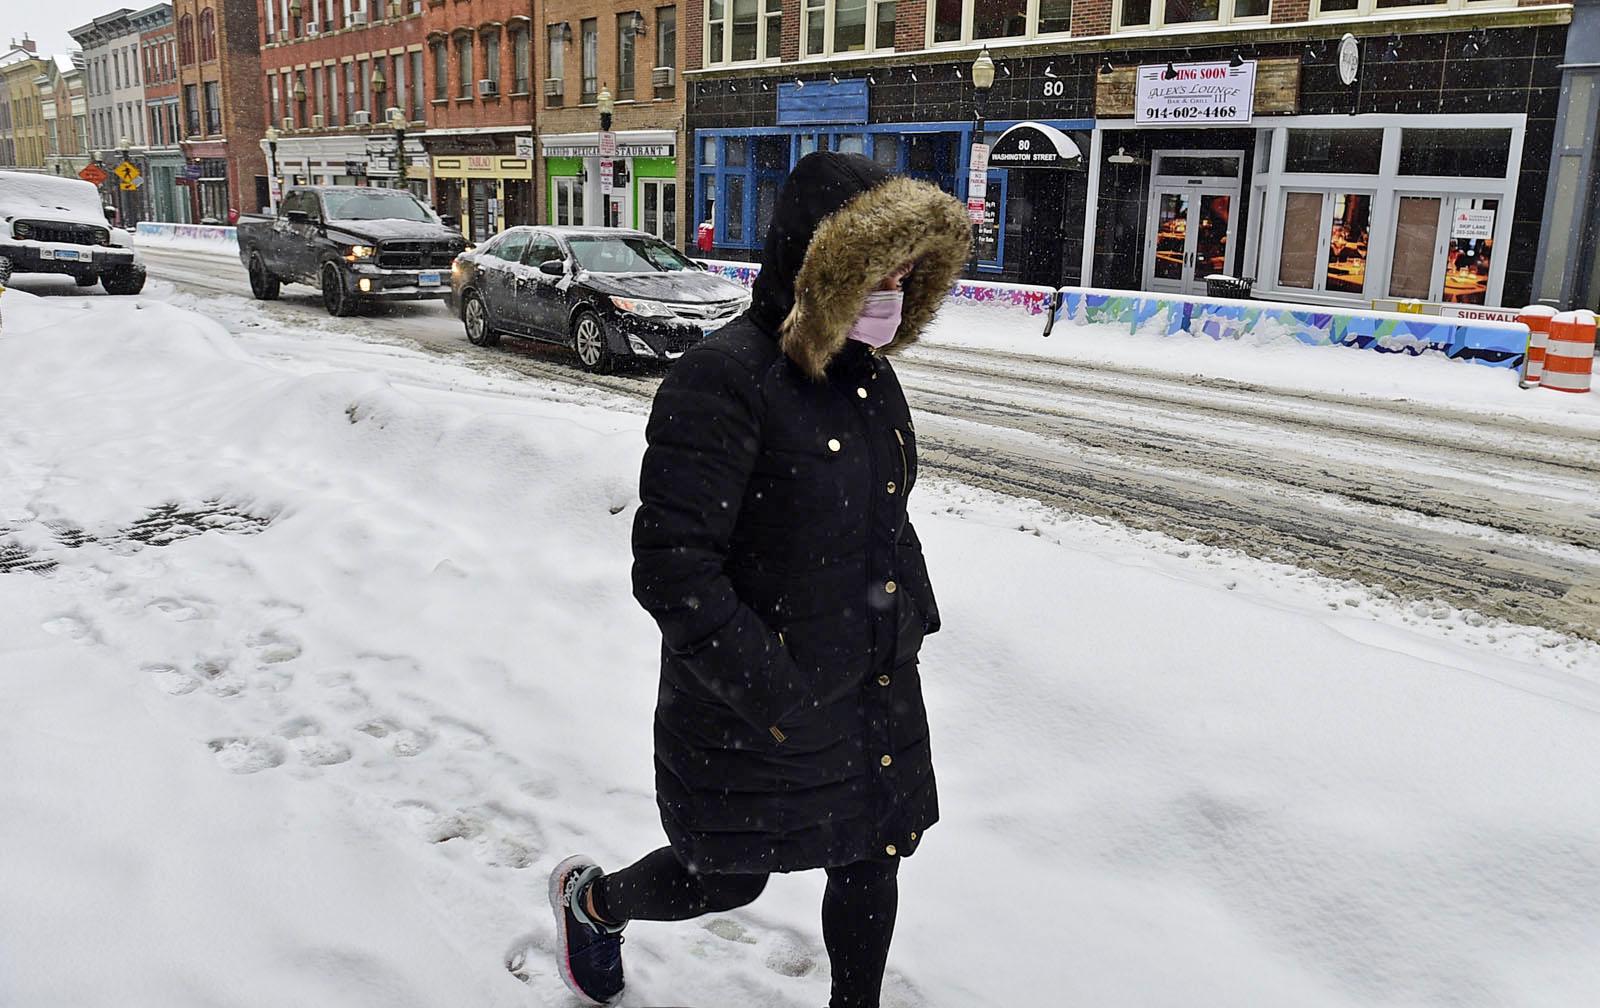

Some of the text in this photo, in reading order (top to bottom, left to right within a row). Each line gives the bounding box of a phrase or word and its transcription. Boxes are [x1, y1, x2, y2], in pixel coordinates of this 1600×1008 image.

[1160, 68, 1226, 80] CMING SOON
[1043, 81, 1064, 96] 80
[1146, 105, 1237, 118] 914-602-4468
[615, 146, 663, 156] STAURANT
[1018, 140, 1030, 150] 80
[1457, 311, 1520, 323] SIDEWALK
